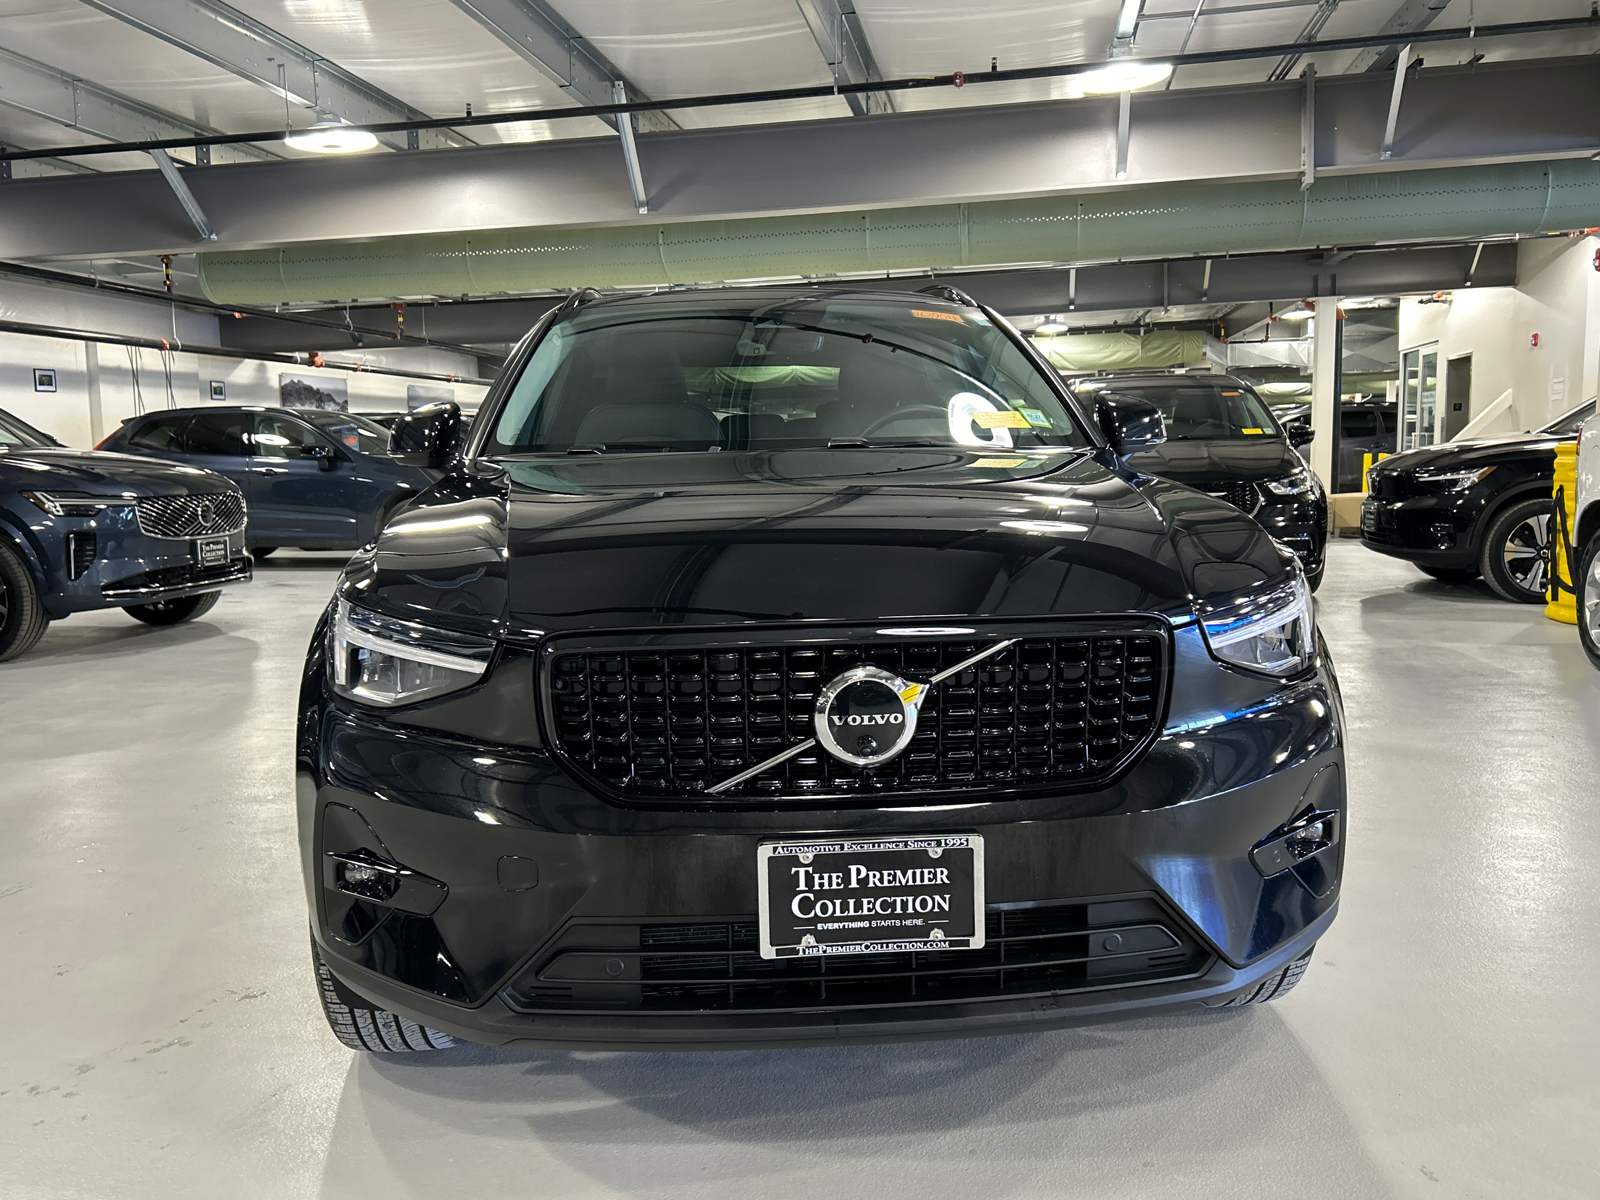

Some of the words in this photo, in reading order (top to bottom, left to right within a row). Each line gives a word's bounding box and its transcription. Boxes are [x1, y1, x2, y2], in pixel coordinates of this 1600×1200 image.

[830, 713, 903, 726] VOLVO
[775, 845, 841, 855] AUTOMOTIVE
[843, 842, 905, 851] EXCELLENCE
[907, 840, 937, 849] SINCE
[941, 838, 967, 847] 1995
[791, 866, 844, 890] THE
[848, 865, 950, 888] PREMIER
[791, 893, 950, 918] COLLECTION
[817, 921, 869, 930] EVERYTHING
[871, 920, 900, 928] STARTS
